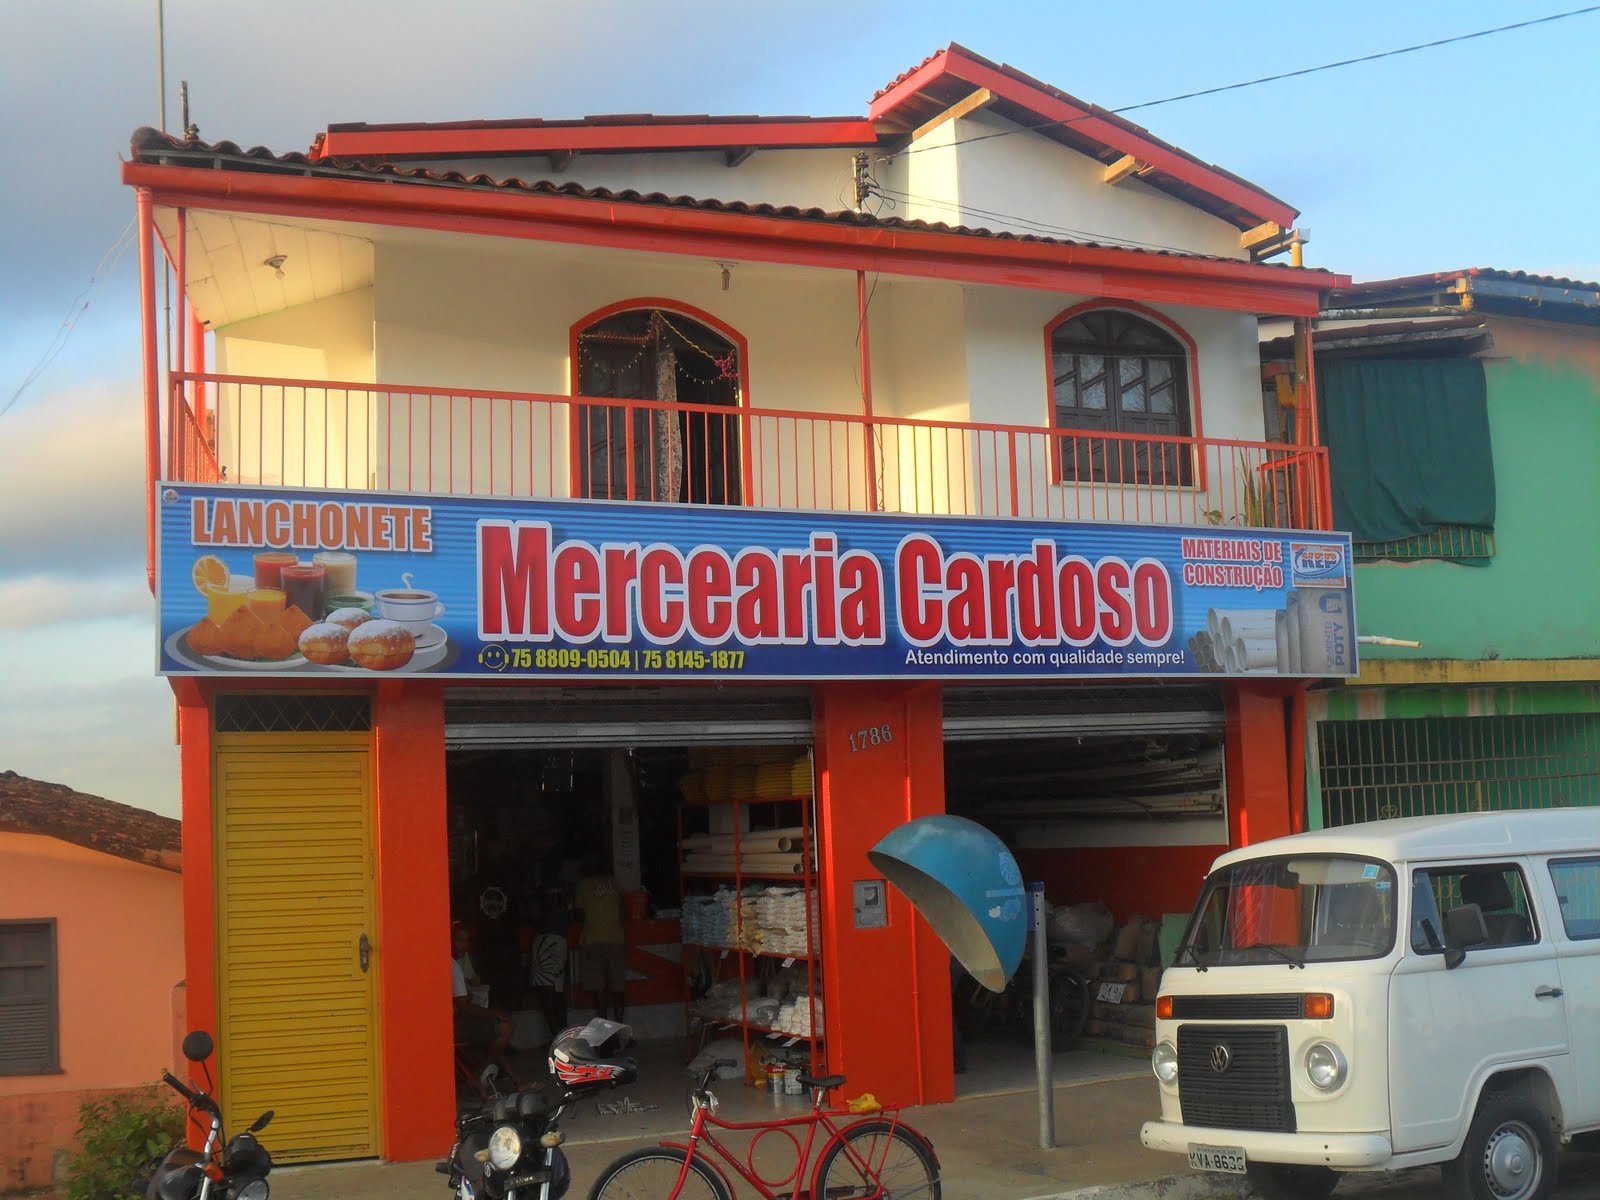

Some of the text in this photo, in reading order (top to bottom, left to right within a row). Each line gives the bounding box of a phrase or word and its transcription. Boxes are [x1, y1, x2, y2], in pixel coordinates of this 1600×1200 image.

[191, 496, 432, 552] LANCHONETE
[1181, 537, 1283, 562] MATERIAIS DE
[476, 519, 1173, 647] Mercearia Cardoso
[1183, 562, 1284, 591] CONSTRUÇÃO
[511, 648, 745, 669] 75 8809-0504 75 8145-1877
[905, 649, 1185, 668] Atendimento com qualidade sempre!
[1335, 622, 1345, 667] POTY
[849, 724, 892, 752] 1786
